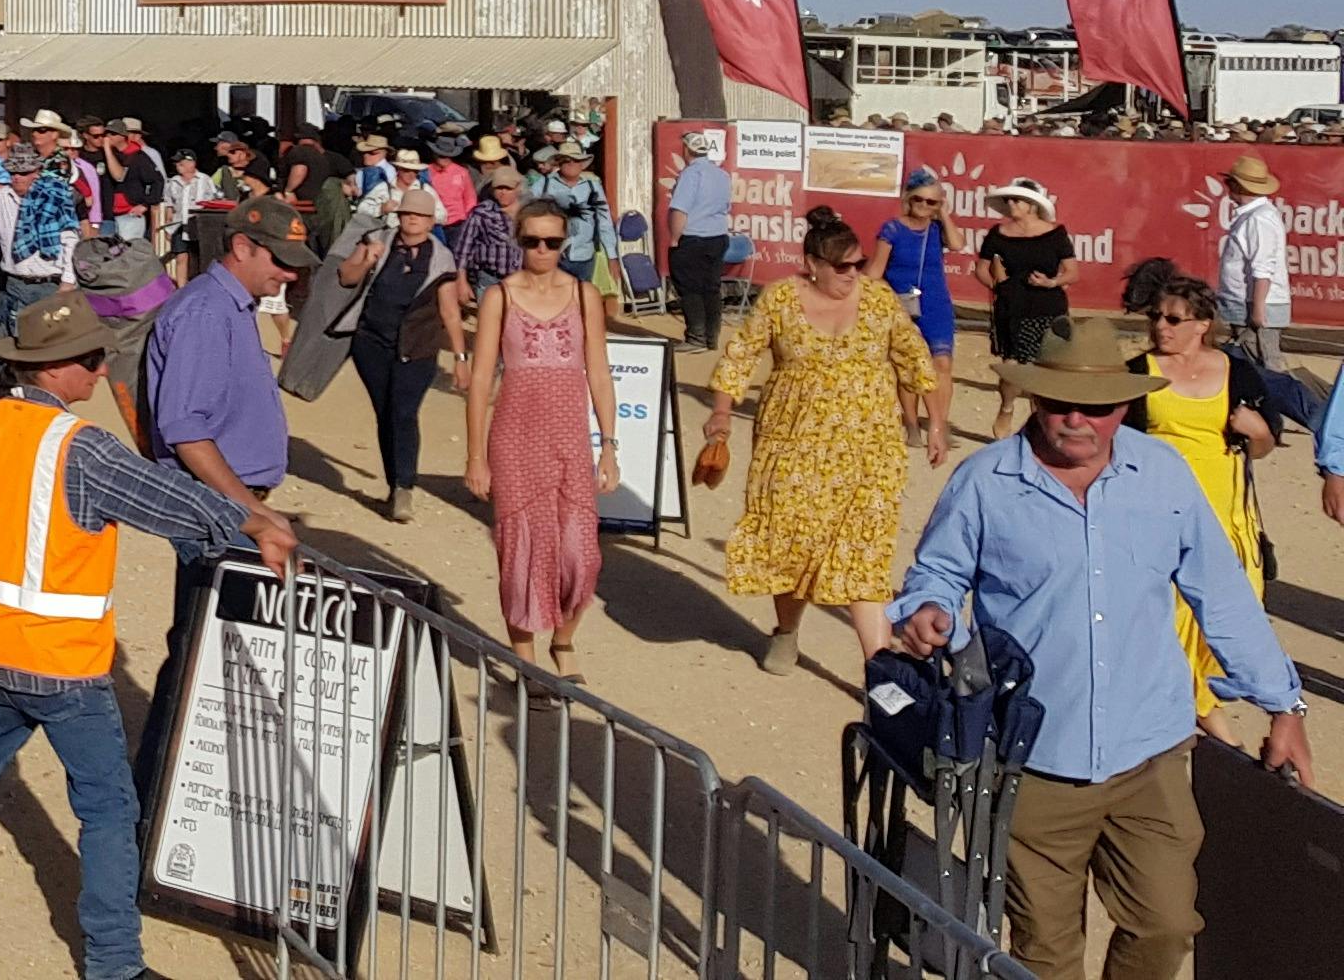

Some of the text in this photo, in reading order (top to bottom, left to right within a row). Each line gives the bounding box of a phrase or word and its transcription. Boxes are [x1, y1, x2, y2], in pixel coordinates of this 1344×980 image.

[731, 172, 794, 206] back
[609, 364, 648, 374] garoo
[223, 631, 243, 654] NO
[249, 637, 278, 660] ATM
[343, 656, 369, 681] ut
[272, 669, 305, 695] rae
